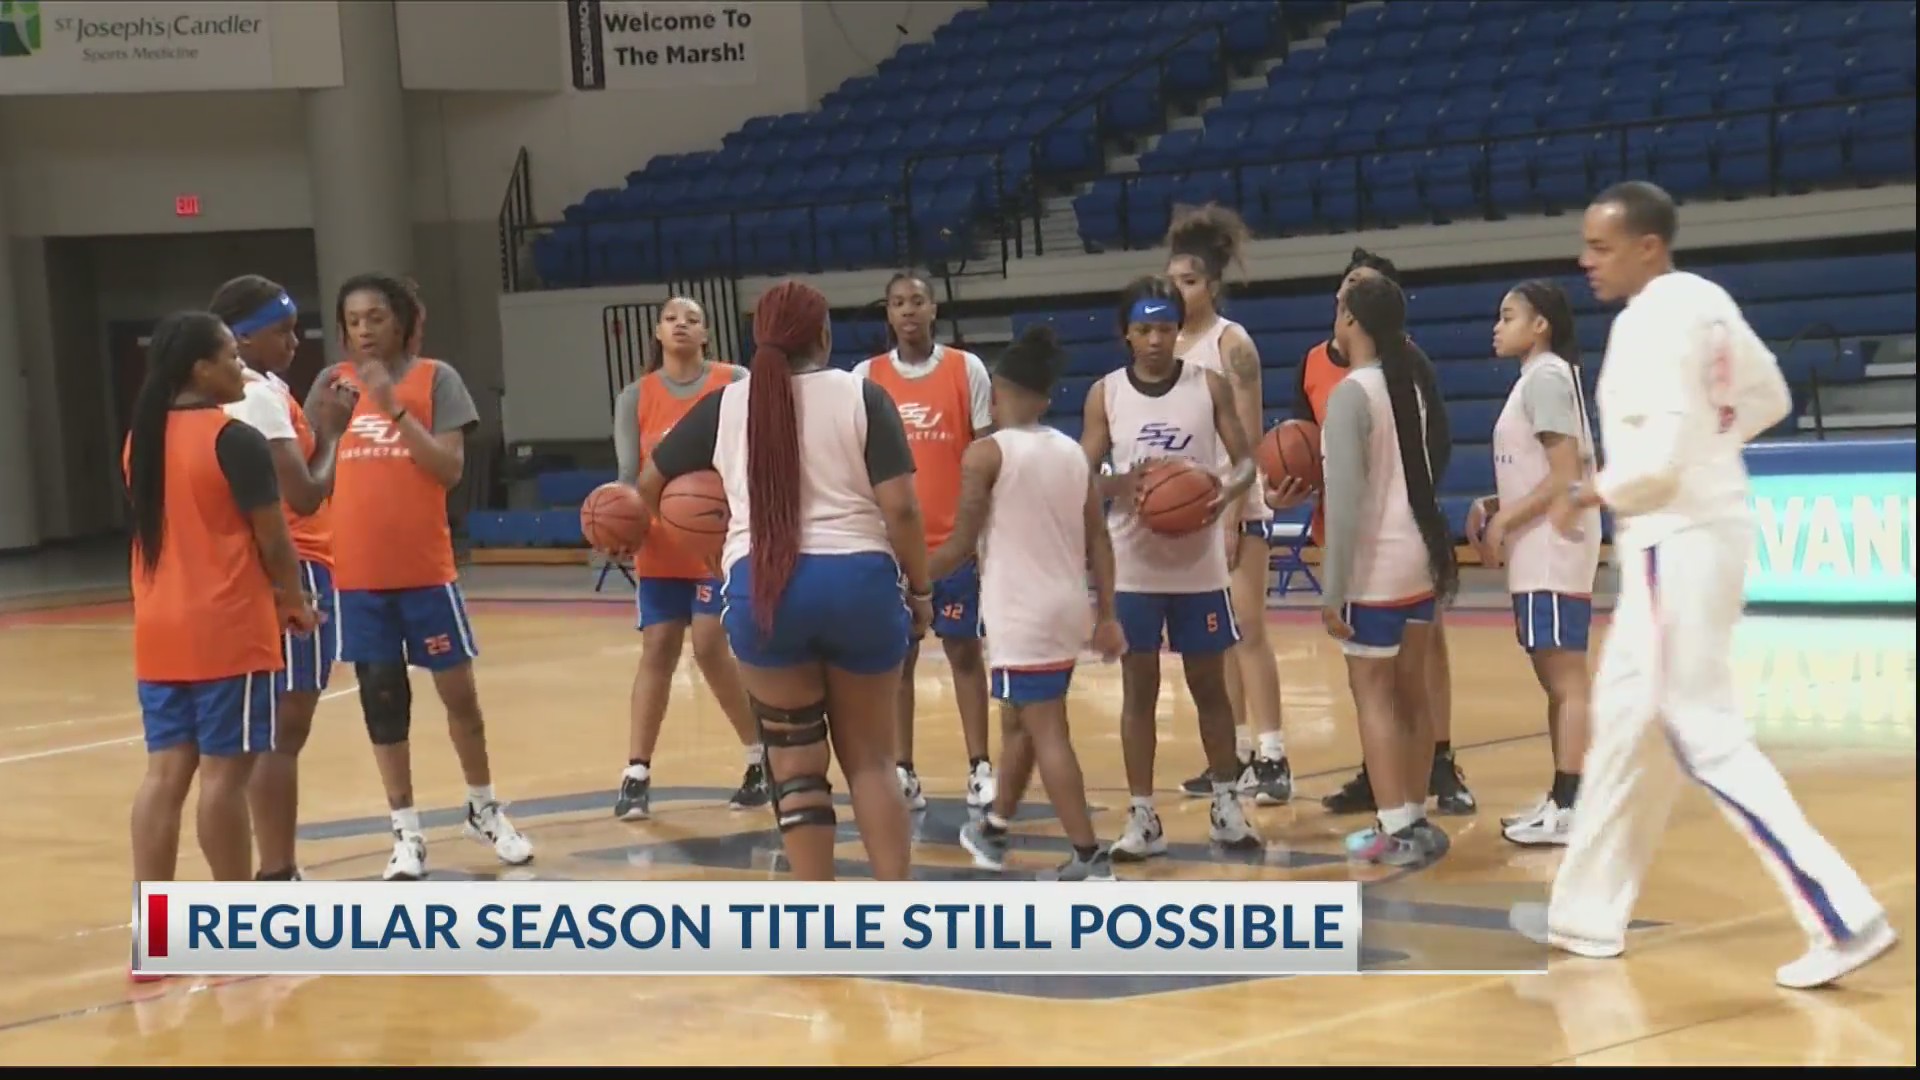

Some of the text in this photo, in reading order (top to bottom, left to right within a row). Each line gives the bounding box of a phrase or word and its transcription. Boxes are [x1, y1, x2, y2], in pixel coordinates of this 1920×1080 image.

[604, 9, 752, 33] Welcome To
[82, 47, 199, 62] Sports Medicine
[614, 42, 745, 66] The Marsh!
[1744, 496, 1916, 577] VAN
[424, 634, 451, 656] 25
